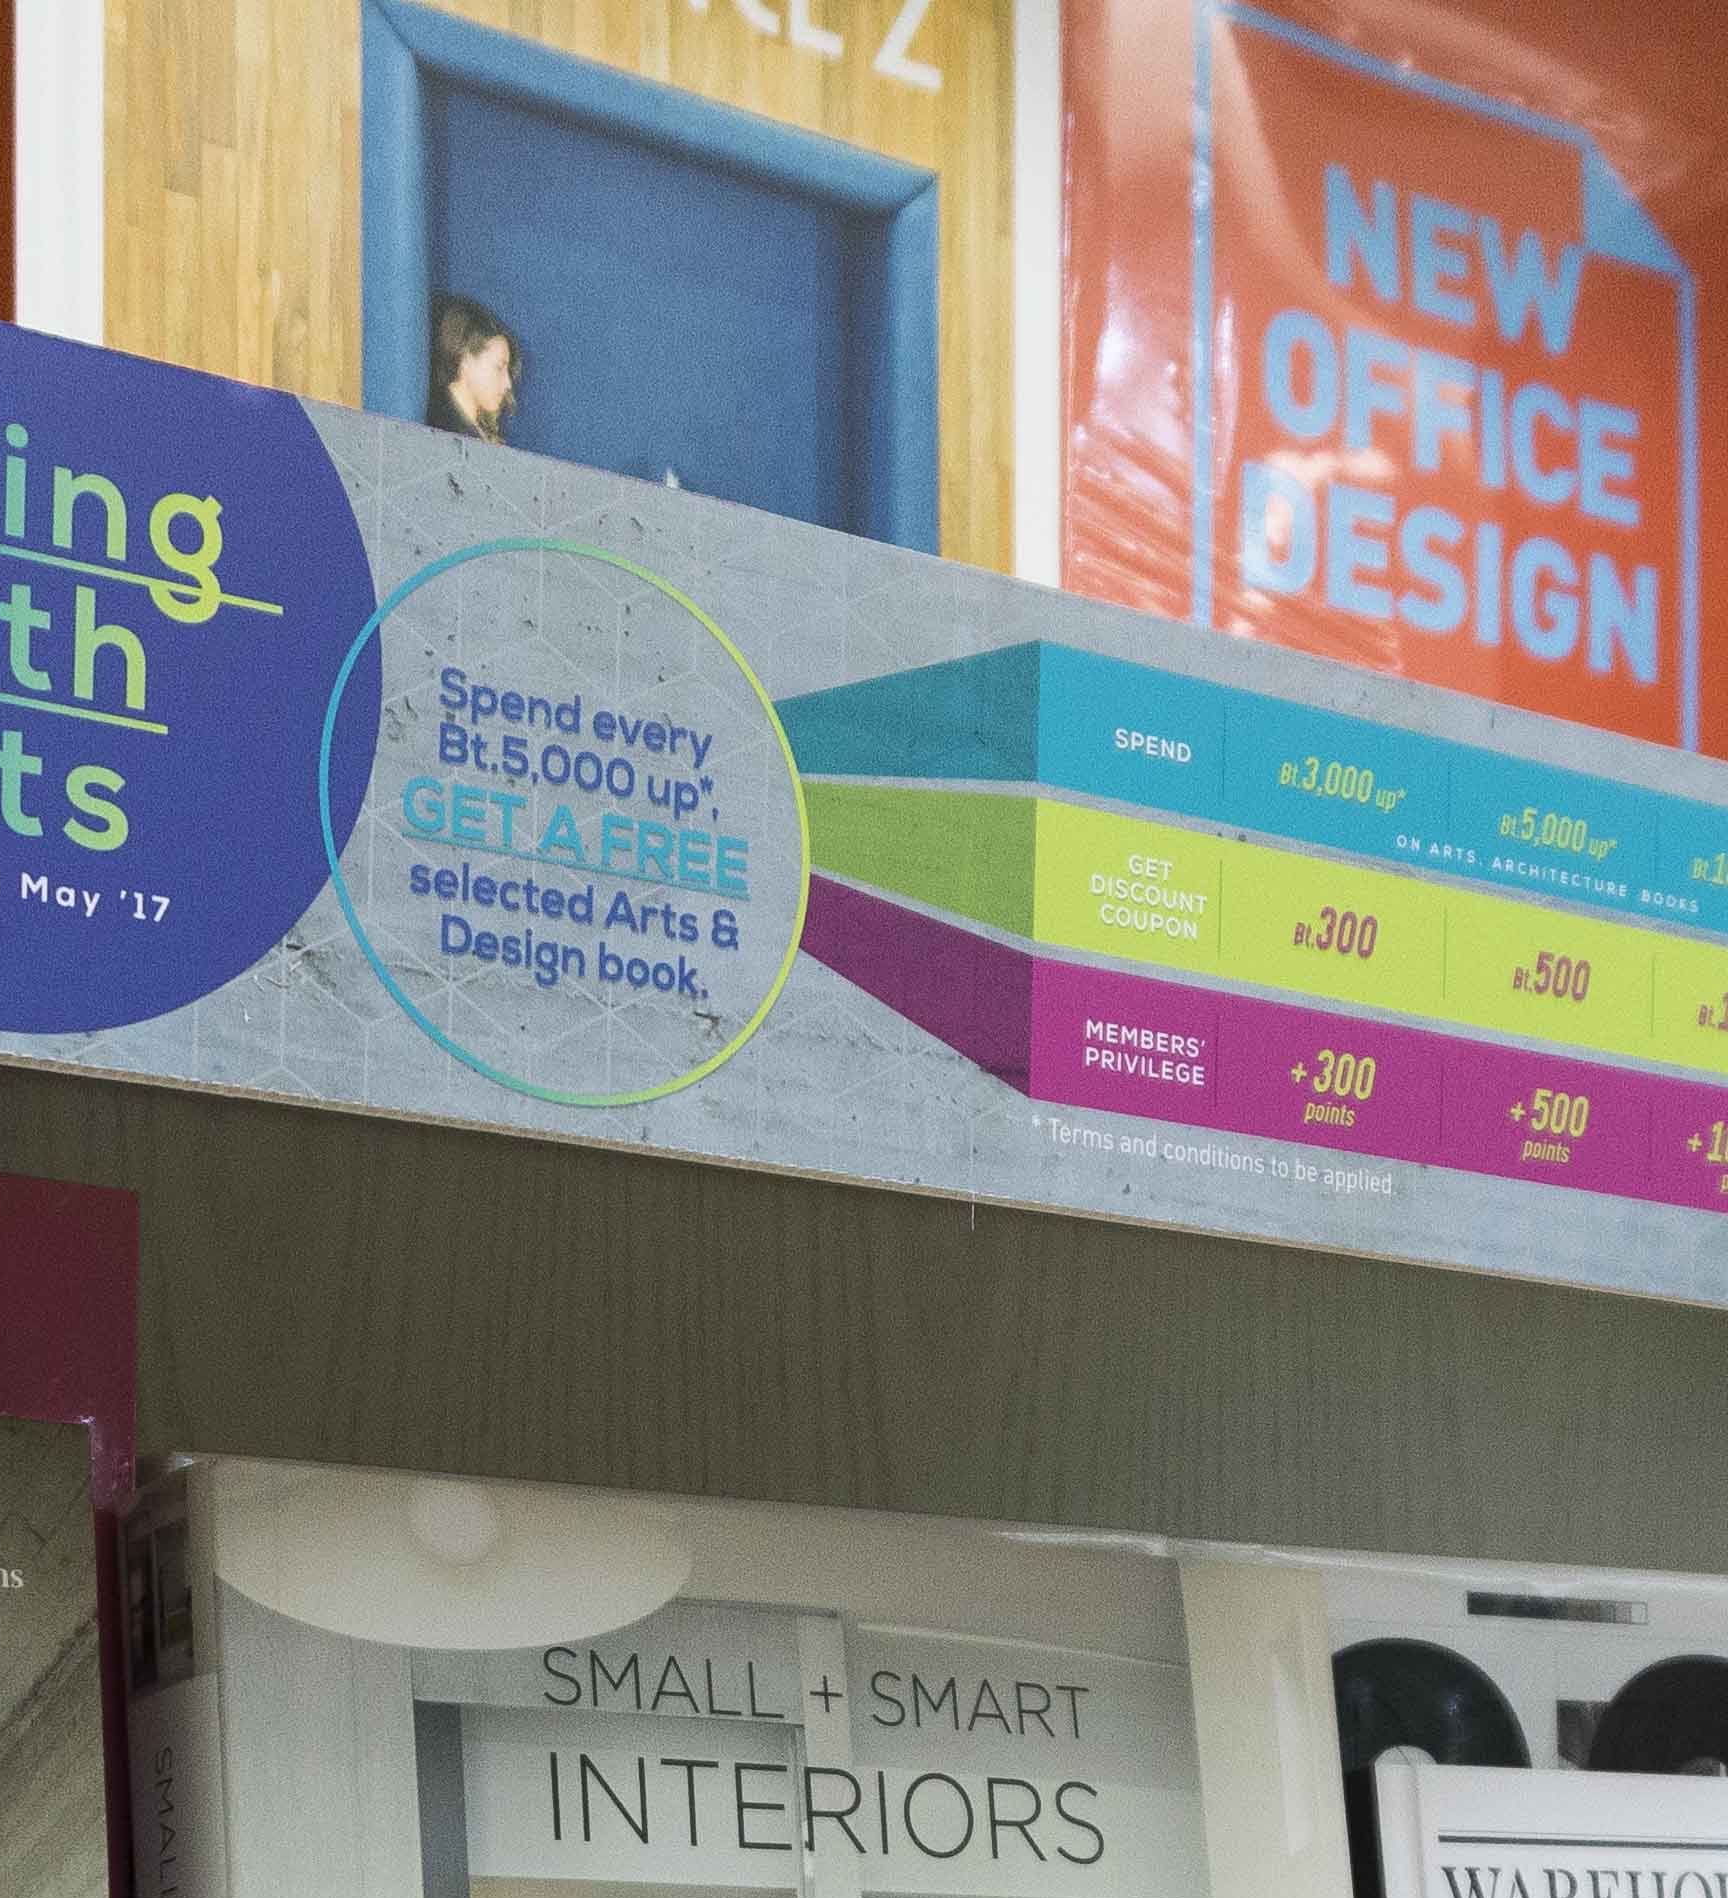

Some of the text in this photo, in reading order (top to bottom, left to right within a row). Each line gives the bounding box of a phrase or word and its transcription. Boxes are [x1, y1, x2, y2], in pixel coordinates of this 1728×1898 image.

[1325, 162, 1583, 356] NEW
[1262, 308, 1642, 525] OFFICE
[1240, 459, 1660, 686] DESIGN
[439, 667, 713, 767] Spend every
[438, 722, 635, 787] Bt.5,000
[1113, 727, 1193, 764] SPEND
[1278, 754, 1375, 807] Bt.3,000
[402, 776, 749, 891] GET A FREE
[1498, 808, 1588, 856] Bt.5,000
[1089, 872, 1209, 918] DISCOUNT
[1127, 853, 1175, 882] GET
[1395, 833, 1421, 855] ON
[1491, 855, 1629, 900] ARCHITECTURE
[1640, 887, 1701, 915] BOOKS
[19, 868, 102, 919] May
[118, 888, 172, 924] '17
[409, 860, 739, 950] selected Arts &
[1100, 903, 1199, 943] COUPON
[440, 914, 708, 999] Design book.
[1292, 905, 1378, 960] Bt.300
[1511, 952, 1591, 1003] Bt.500
[1084, 1019, 1208, 1058] MEMBERS'
[1084, 1046, 1206, 1088] PRIVILEGE
[1303, 1098, 1356, 1129] points
[1049, 1117, 1111, 1154] Terms
[1118, 1131, 1157, 1159] and
[1164, 1136, 1265, 1176] conditions
[1271, 1154, 1292, 1178] to
[1297, 1157, 1318, 1183] be
[1522, 1137, 1571, 1166] points
[544, 1645, 1090, 1740] SMALL + SMART
[549, 1749, 1105, 1865] INTERIORS
